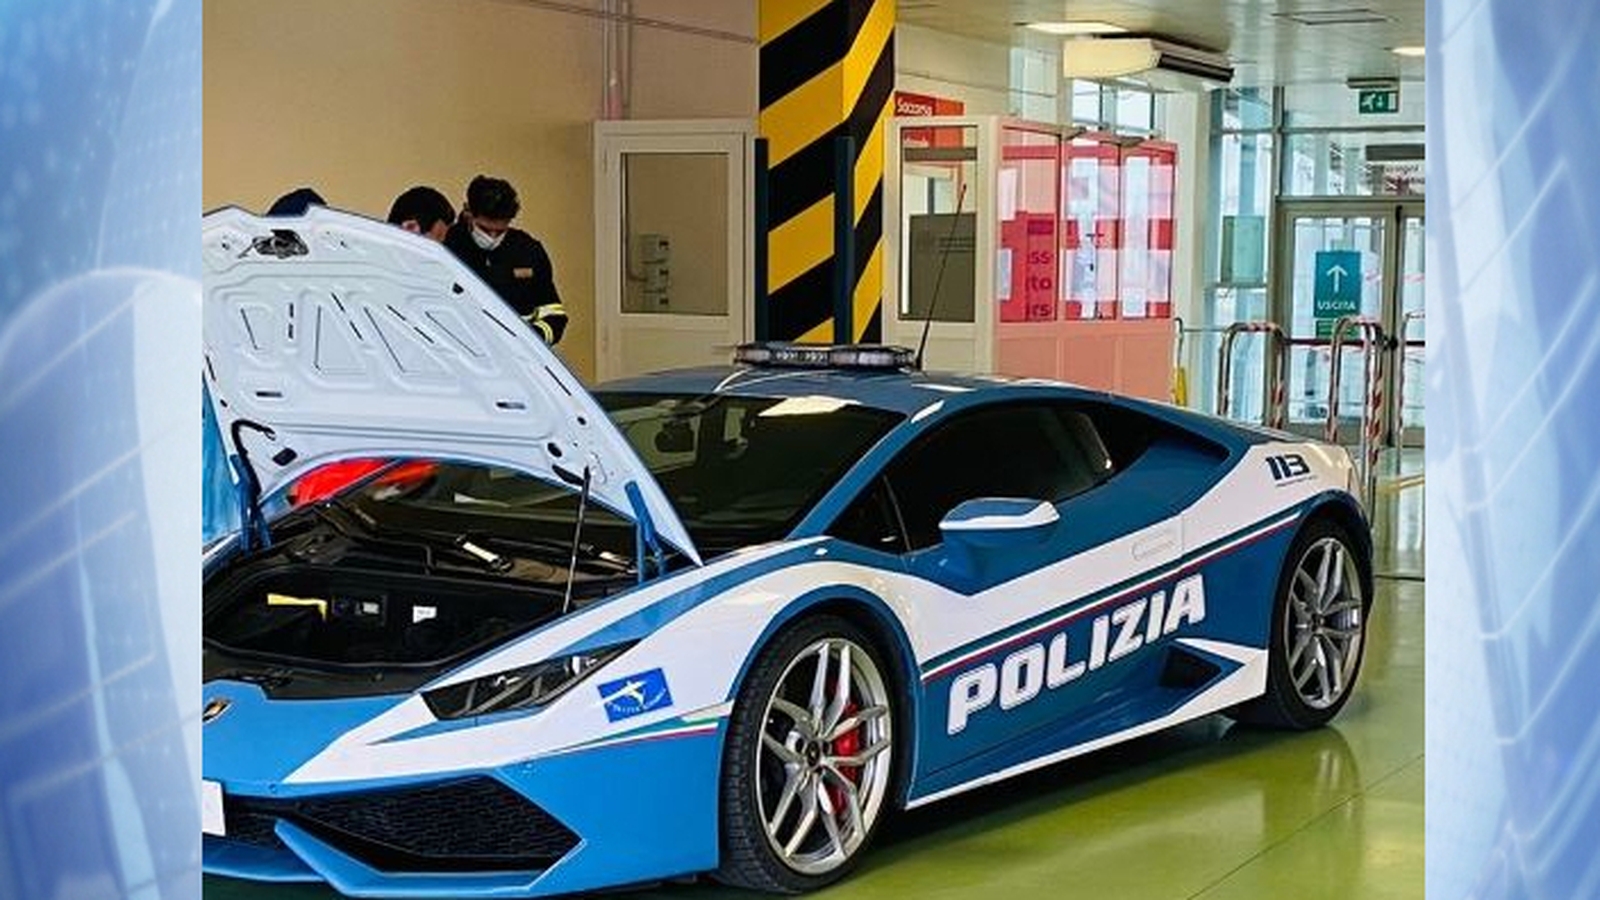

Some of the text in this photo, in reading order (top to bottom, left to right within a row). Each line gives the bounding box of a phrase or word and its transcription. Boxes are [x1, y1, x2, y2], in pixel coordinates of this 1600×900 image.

[1317, 300, 1357, 310] USCITA
[1265, 454, 1311, 481] 113
[947, 573, 1206, 736] POLIZIA
